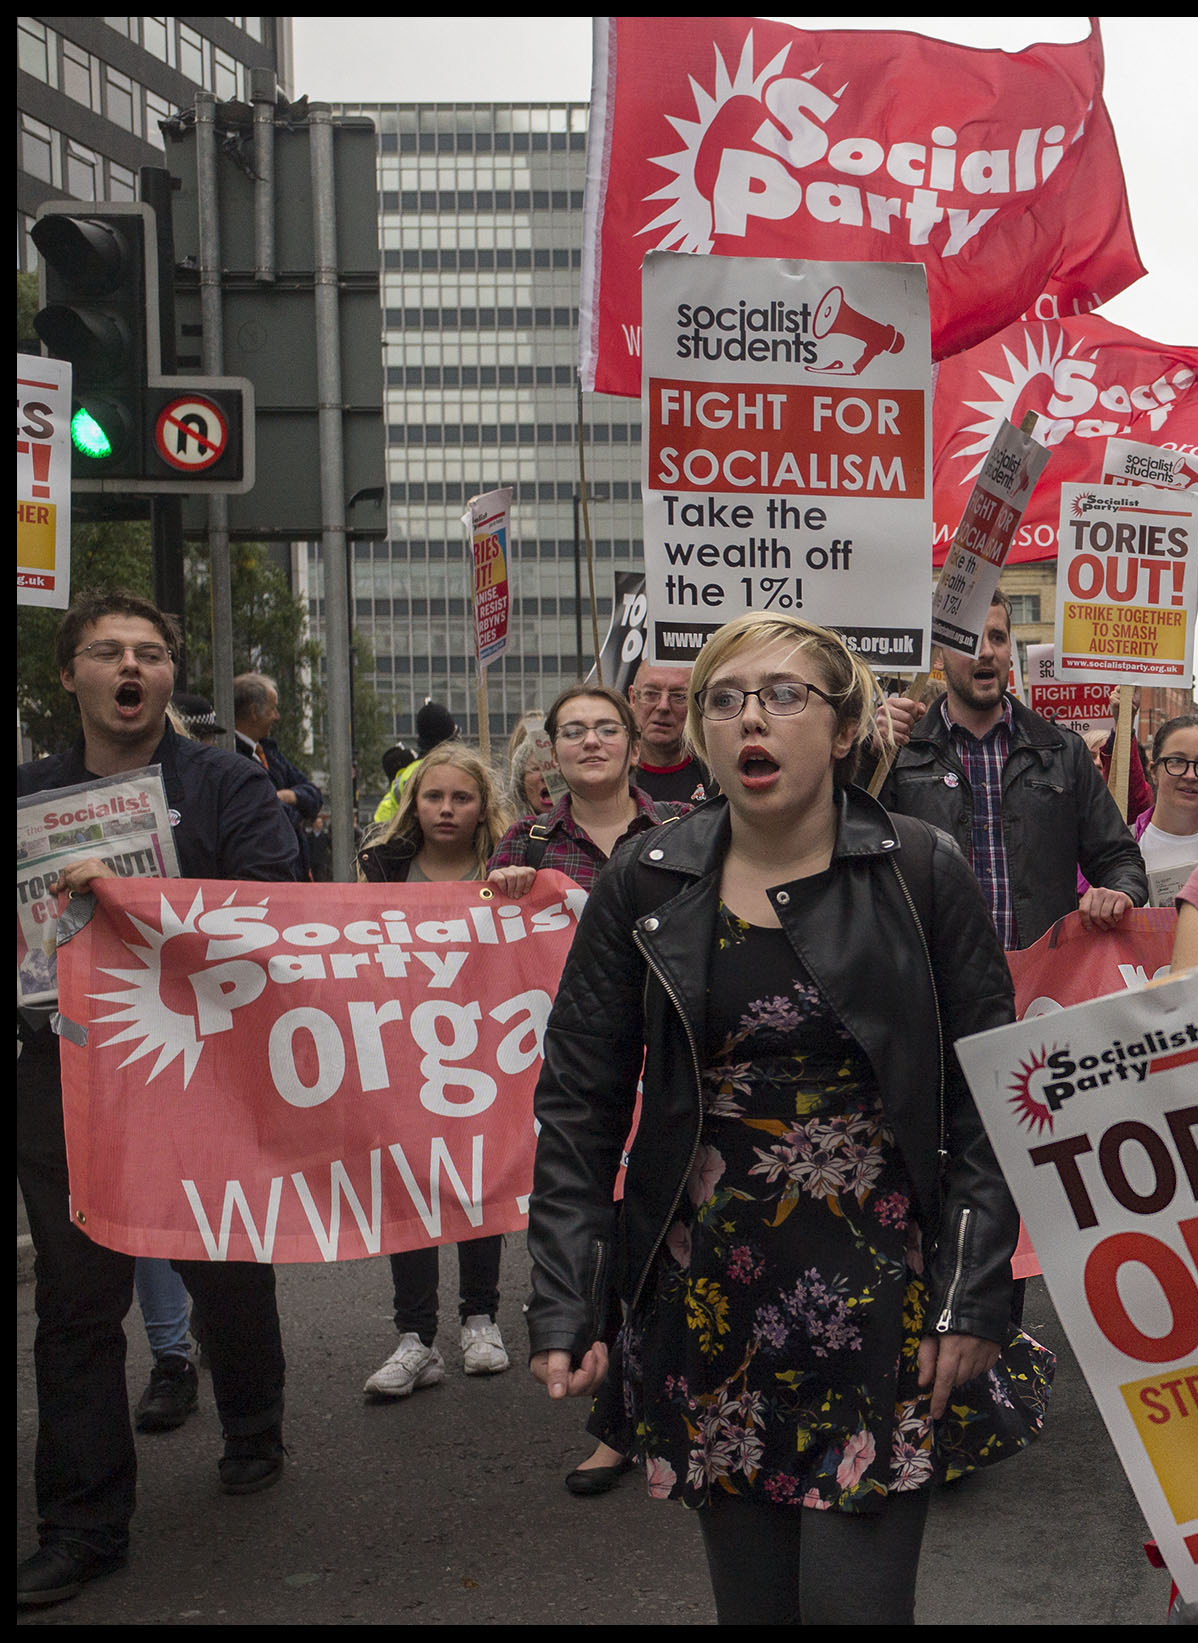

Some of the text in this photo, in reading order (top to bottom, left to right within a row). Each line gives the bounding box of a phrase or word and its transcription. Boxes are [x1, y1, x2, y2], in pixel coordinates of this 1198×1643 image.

[752, 76, 1080, 194] Sociali
[714, 149, 1000, 257] Party
[677, 301, 812, 334] socialist
[676, 330, 818, 364] students
[660, 388, 901, 435] FIGHT FOR
[658, 446, 907, 492] SOCIALISM
[1124, 462, 1174, 484] students
[1126, 453, 1174, 472] socialist
[663, 496, 827, 531] Take the
[1082, 503, 1120, 514] Party
[1087, 494, 1140, 508] Socialist
[664, 536, 853, 571] wealth off
[1070, 519, 1189, 559] TORIES
[665, 574, 804, 611] the 1%!
[1067, 553, 1187, 606] OUT!
[1068, 604, 1182, 627] STRIKE TOGETHER
[1092, 622, 1158, 641] TO SMASH
[1089, 638, 1159, 657] AUSTERITY
[1066, 658, 1178, 674] www.socialistparty.org.uk
[1035, 685, 1111, 700] FIGHT FOR
[1071, 721, 1090, 731] the
[43, 791, 151, 831] Socialist
[188, 944, 470, 1036] Party
[1043, 1056, 1153, 1112] Party
